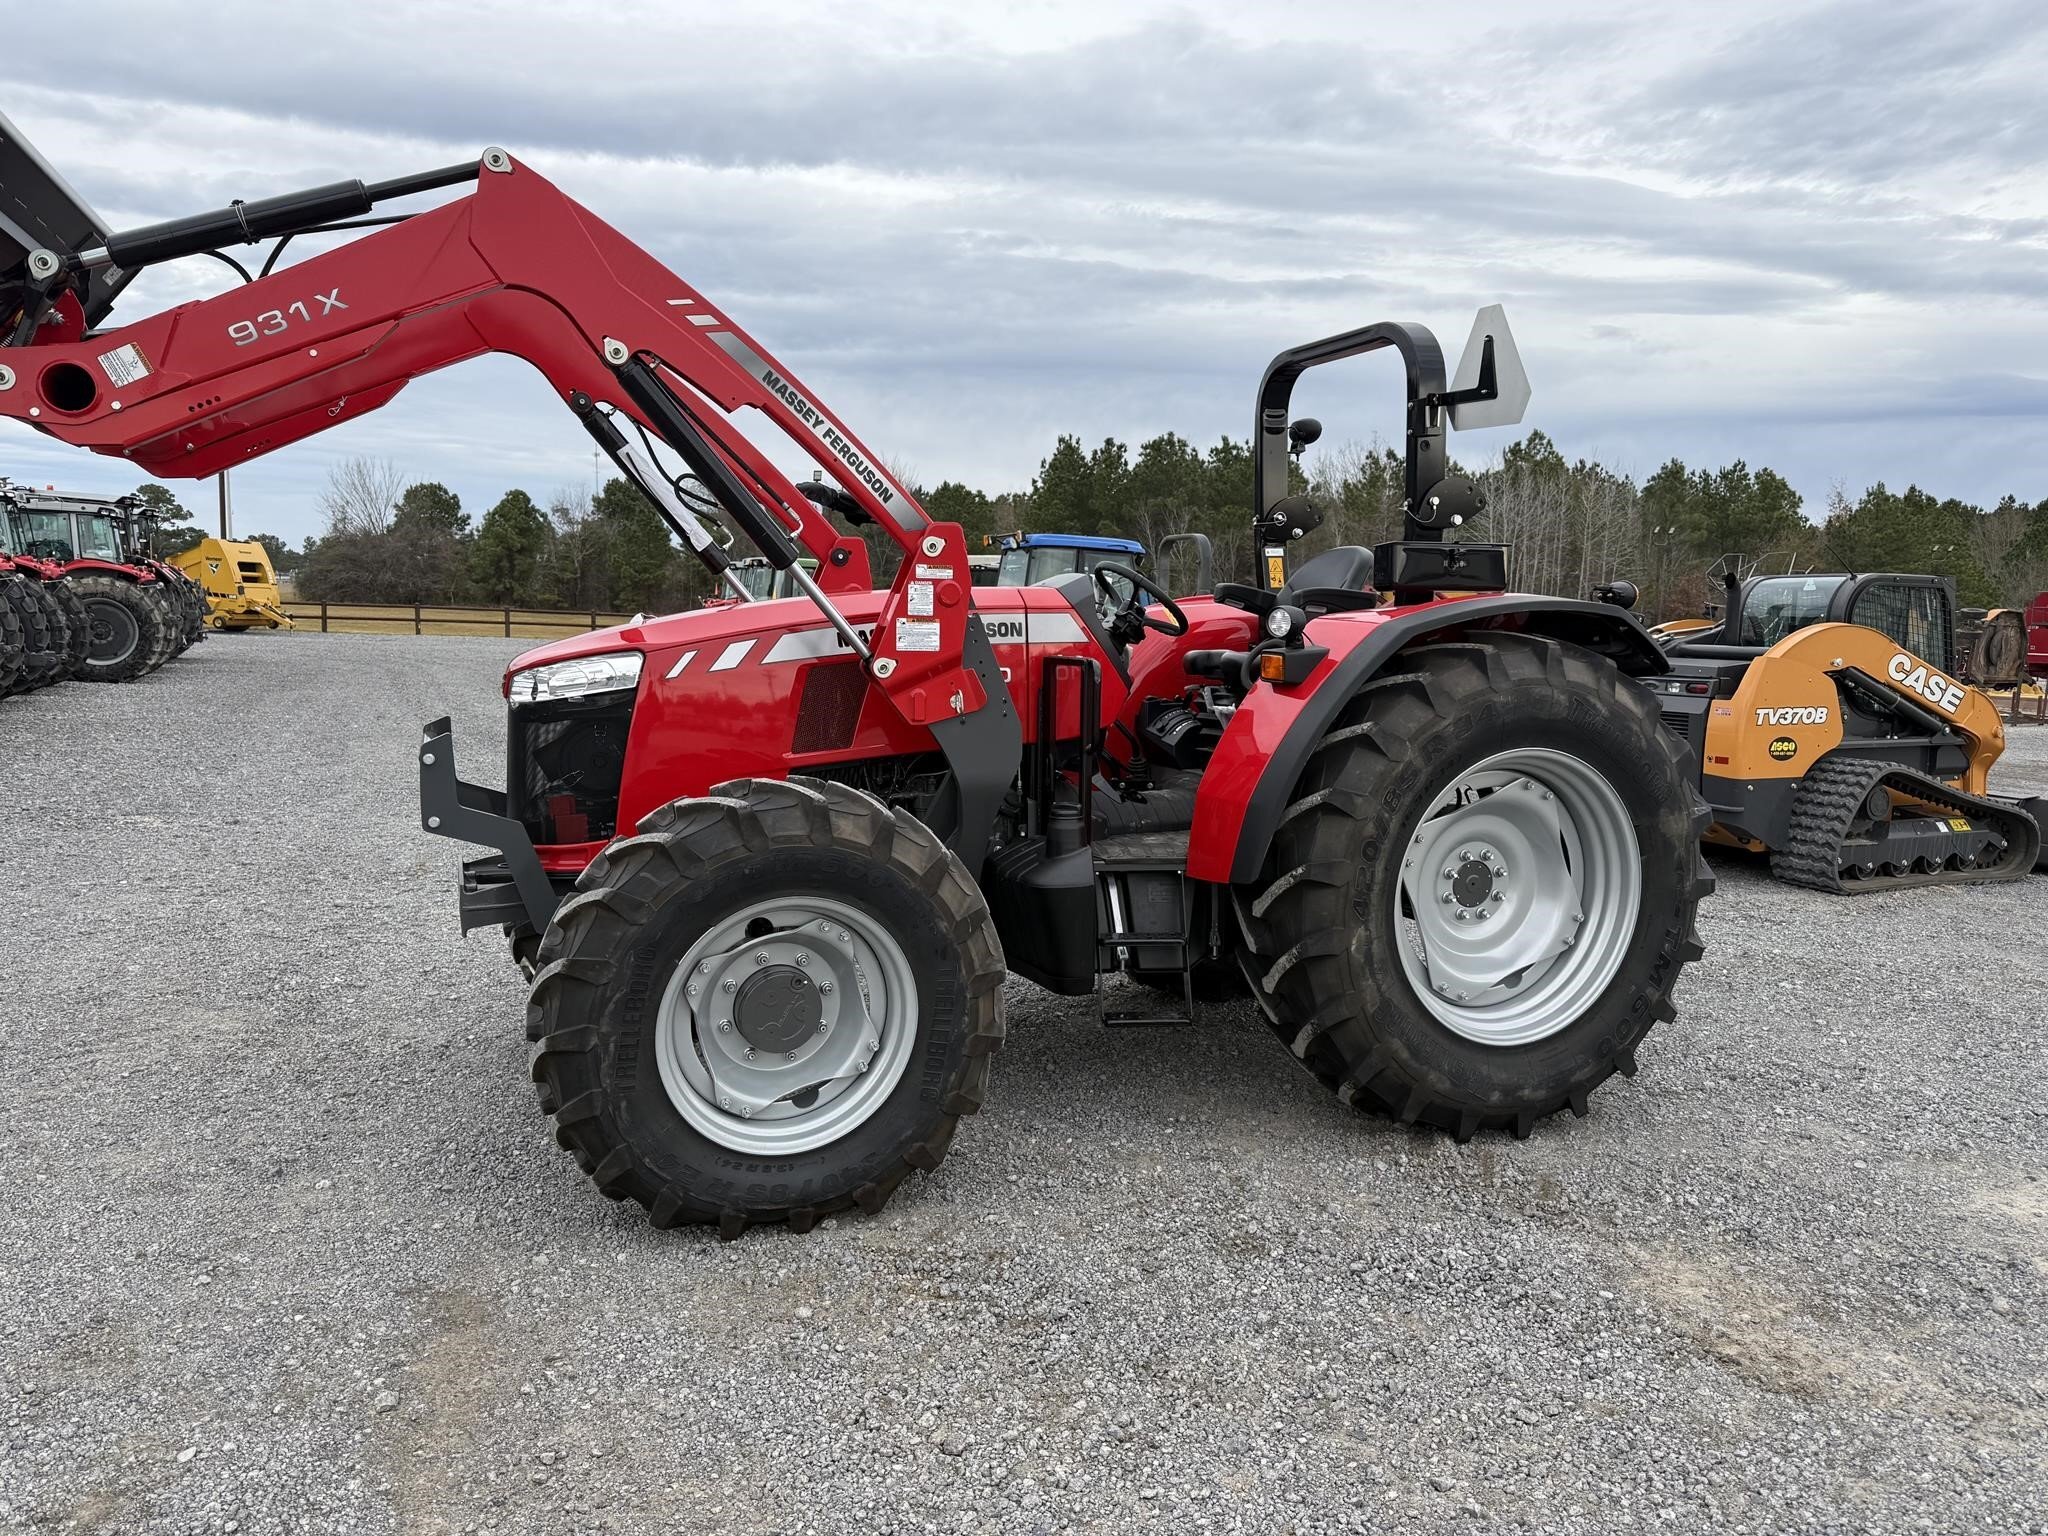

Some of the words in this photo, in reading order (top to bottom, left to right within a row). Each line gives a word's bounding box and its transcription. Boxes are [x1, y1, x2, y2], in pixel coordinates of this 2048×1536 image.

[762, 370, 824, 429] MASSEY
[822, 427, 894, 504] FERGUSON
[1887, 653, 1966, 715] CASE
[1755, 706, 1828, 726] TV370B
[1770, 741, 1796, 751] ASCO
[920, 968, 957, 1102] TRELLEBORG
